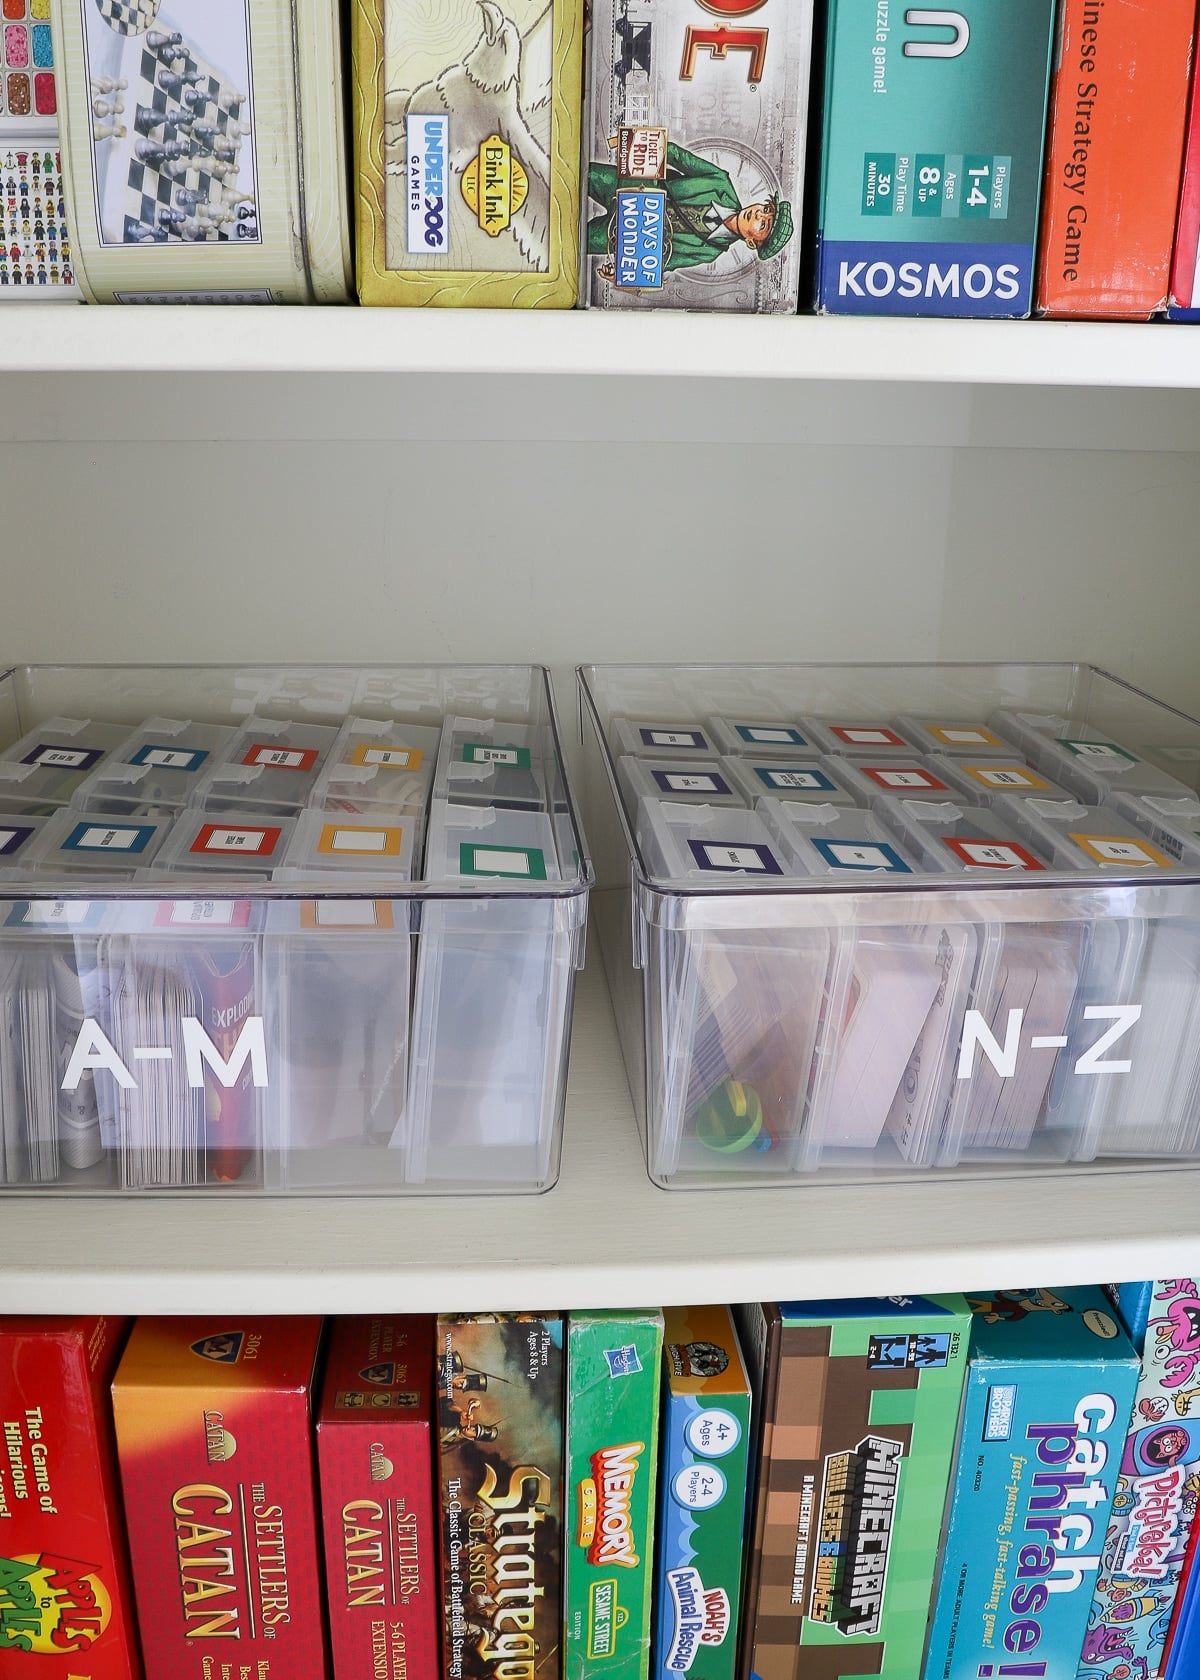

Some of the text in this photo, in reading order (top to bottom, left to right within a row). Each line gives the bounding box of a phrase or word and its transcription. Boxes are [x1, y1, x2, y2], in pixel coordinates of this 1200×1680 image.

[872, 47, 887, 94] game!
[620, 130, 629, 175] Boardgame
[631, 131, 649, 176] TO RIDE
[649, 131, 661, 167] TICKET
[1064, 83, 1098, 196] Strategy
[411, 155, 420, 211] GAMES
[424, 121, 443, 247] UNDERDOG
[466, 176, 476, 195] LLC
[485, 147, 504, 225] Bink Ink
[866, 162, 877, 207] MINUTES
[877, 174, 891, 196] 30
[895, 157, 909, 213] Play Time
[918, 166, 941, 203] 8 & UP
[944, 172, 957, 200] Ages
[966, 165, 990, 207] 1-4
[993, 166, 1006, 209] Players
[620, 197, 640, 283] WONDER
[641, 197, 661, 283] DAYS OF
[1063, 205, 1087, 281] Game
[837, 260, 1020, 300] KOSMOS
[243, 1333, 262, 1360] 3061
[527, 1331, 539, 1351] Ages
[538, 1338, 551, 1366] Players
[952, 1331, 961, 1342] 26
[444, 1332, 454, 1400] www.stratego.com
[527, 1367, 539, 1380] Up
[700, 1419, 713, 1446] Ages
[716, 1423, 731, 1441] 4+
[987, 1387, 1003, 1438] BROTHERS
[999, 1391, 1014, 1438] PARKER
[203, 1410, 226, 1463] CATAN
[4, 1421, 29, 1500] Hilarious
[25, 1406, 58, 1514] The Game of
[370, 1442, 385, 1482] CATAN
[976, 1455, 985, 1469] NO.
[598, 1444, 642, 1566] MEMORY
[687, 1471, 700, 1503] Players
[701, 1477, 714, 1496] 2-4
[582, 1487, 593, 1538] GAME
[797, 1486, 814, 1543] MINECRAFT
[846, 1437, 901, 1634] MINECRAFT
[1126, 1470, 1180, 1575] Pictureka!
[172, 1483, 242, 1641] CATAN
[251, 1482, 292, 1640] THE SETTLERS OF
[342, 1498, 387, 1607] CATAN
[395, 1498, 421, 1605] THE SETTLERS OF
[467, 1511, 488, 1596] CLASSIC
[477, 1462, 551, 1680] Stratego
[976, 1422, 1087, 1678] phrase!
[448, 1478, 465, 1679] The Classic Game of Battlefield Strategy
[791, 1576, 805, 1605] GAME
[955, 1580, 966, 1598] MORE
[959, 1569, 967, 1579] OR
[37, 1551, 103, 1651] APPLES
[40, 1596, 53, 1609] to
[593, 1584, 612, 1655] SESAME STREET
[671, 1571, 703, 1670] Animal Rescue
[701, 1590, 726, 1643] NOAH'S
[952, 1600, 962, 1620] ADULT
[389, 1621, 406, 1639] 5-6
[574, 1611, 582, 1641] EDITION
[947, 1621, 959, 1650] PLAYERS
[982, 1612, 997, 1649] game!
[371, 1620, 389, 1680] EXTENSIO
[942, 1659, 952, 1680] TEAMS
[945, 1650, 954, 1659] IN
